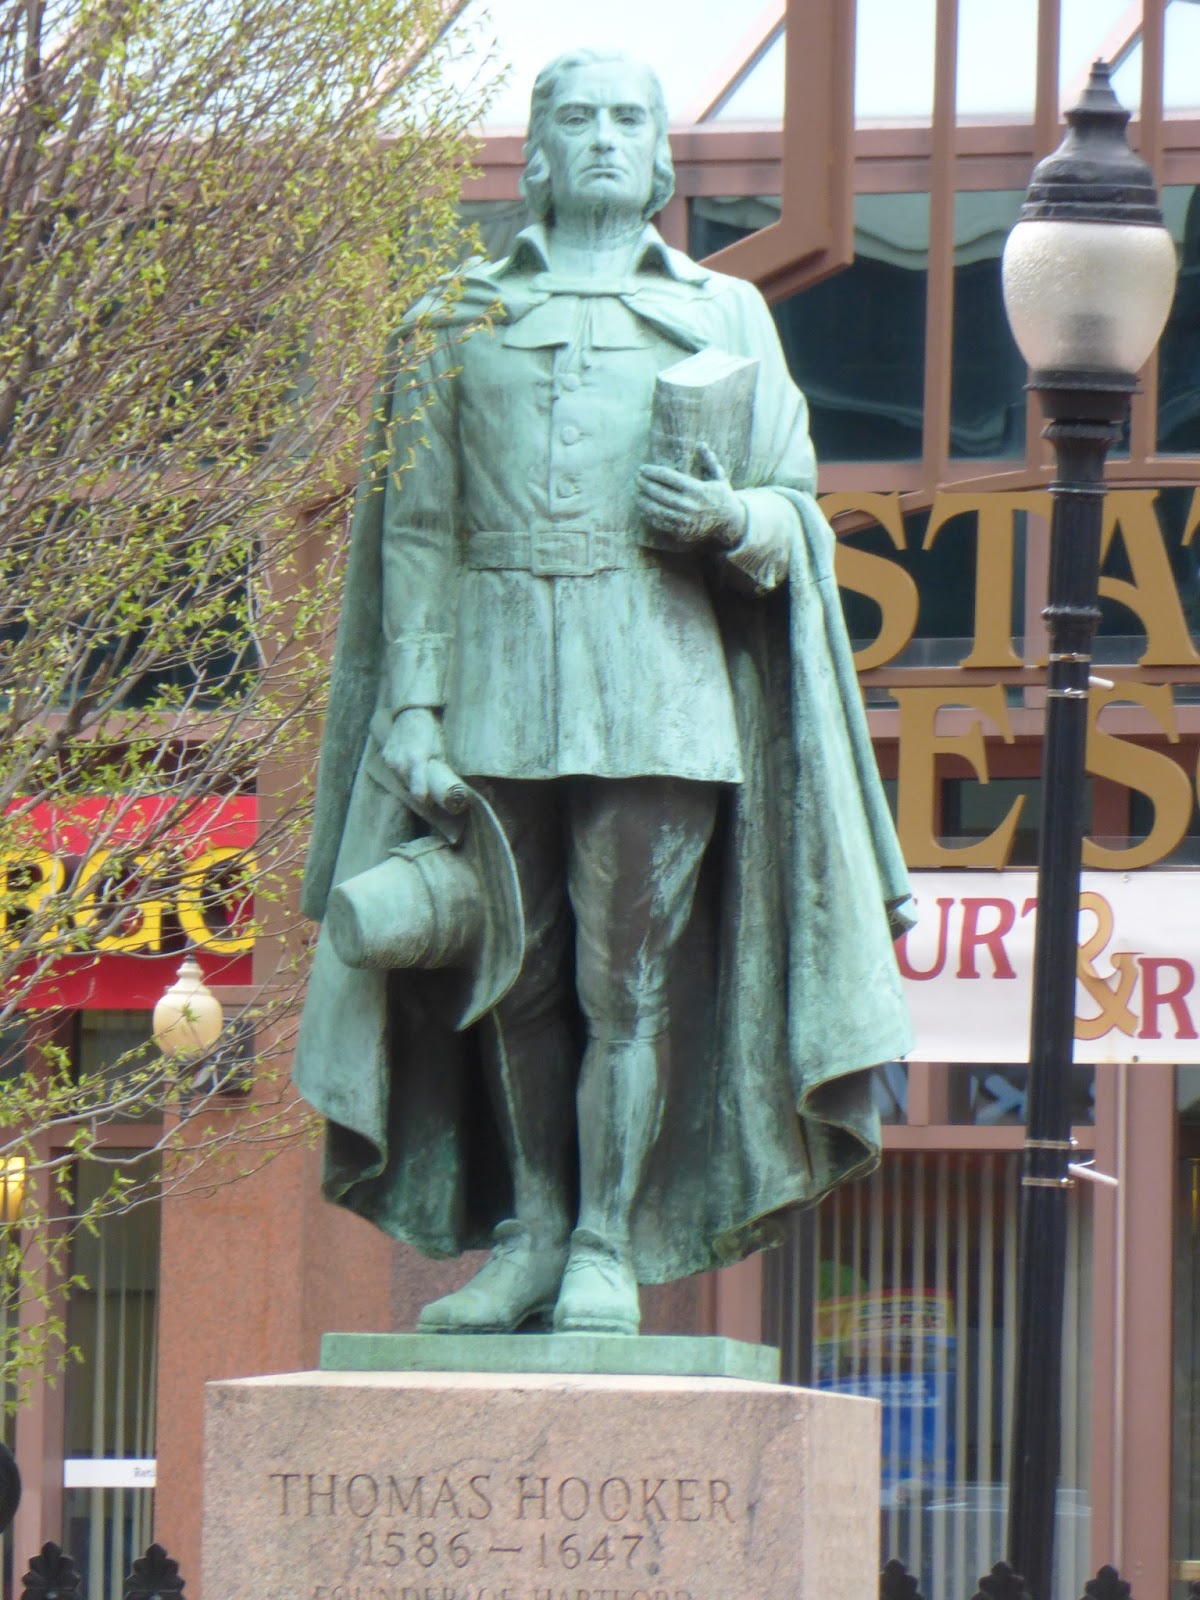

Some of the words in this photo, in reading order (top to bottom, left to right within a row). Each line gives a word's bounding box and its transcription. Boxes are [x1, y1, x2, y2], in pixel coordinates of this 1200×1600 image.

[816, 487, 1200, 671] STA
[889, 683, 1200, 870] ES
[269, 1473, 493, 1520] THOMAS
[516, 1476, 736, 1524] HOOKER
[363, 1532, 472, 1569] 1586
[538, 1532, 645, 1570] 1647
